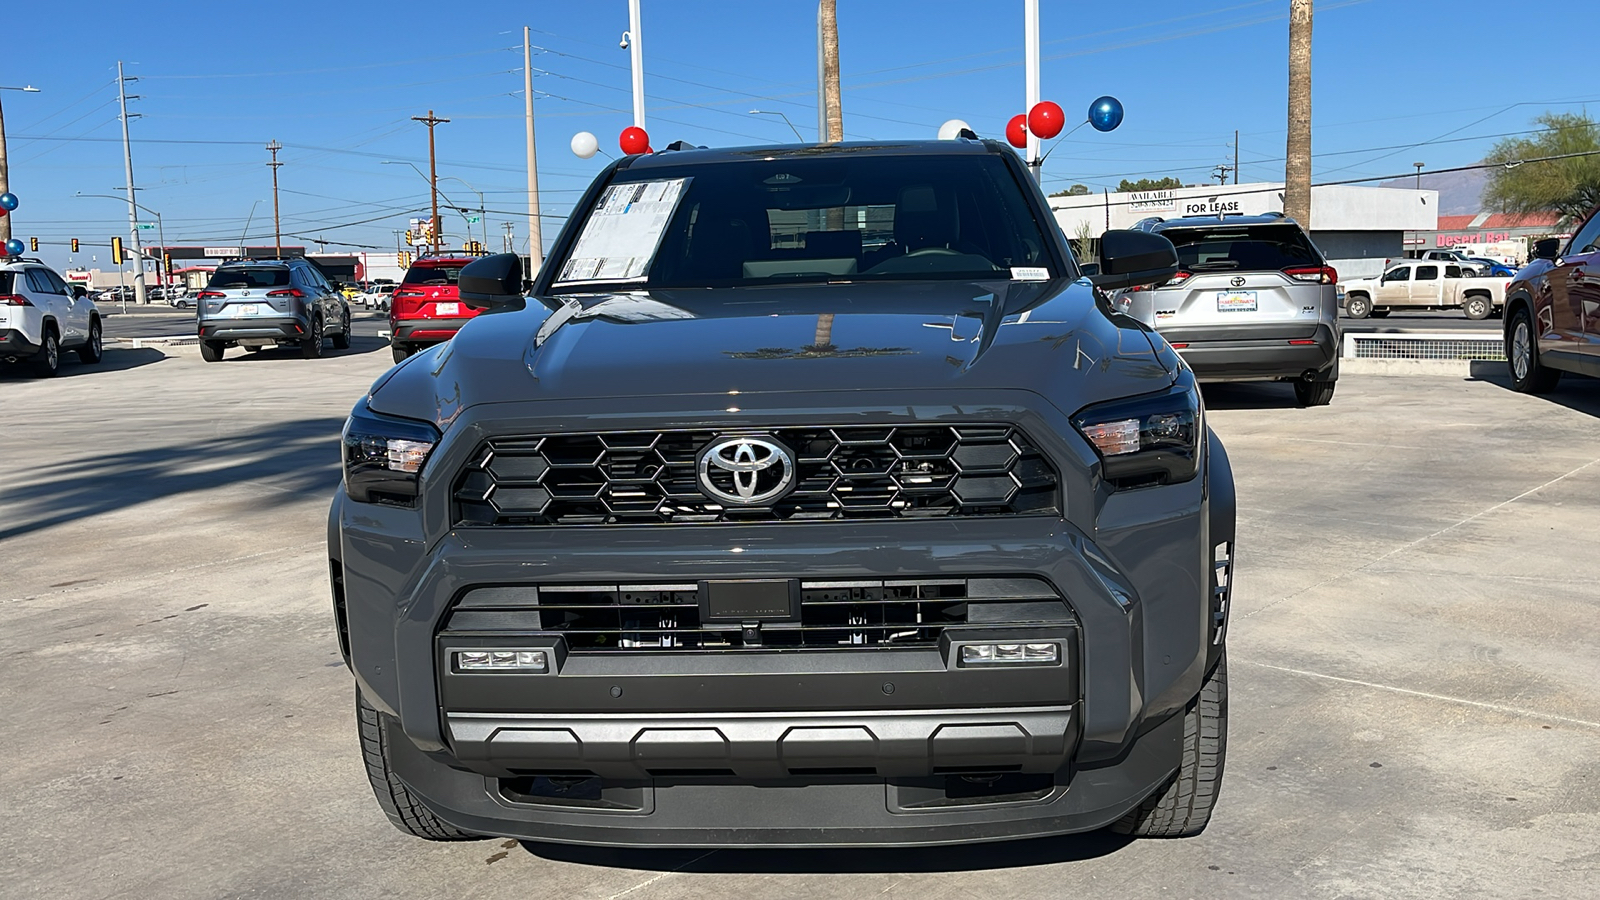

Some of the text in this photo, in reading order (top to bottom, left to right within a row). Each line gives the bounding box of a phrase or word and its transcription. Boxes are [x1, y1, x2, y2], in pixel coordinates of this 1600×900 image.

[1130, 190, 1175, 200] AVAILABLE
[1186, 203, 1206, 213] FOR
[1209, 201, 1239, 212] LEASE
[1436, 232, 1510, 247] Desert Rat
